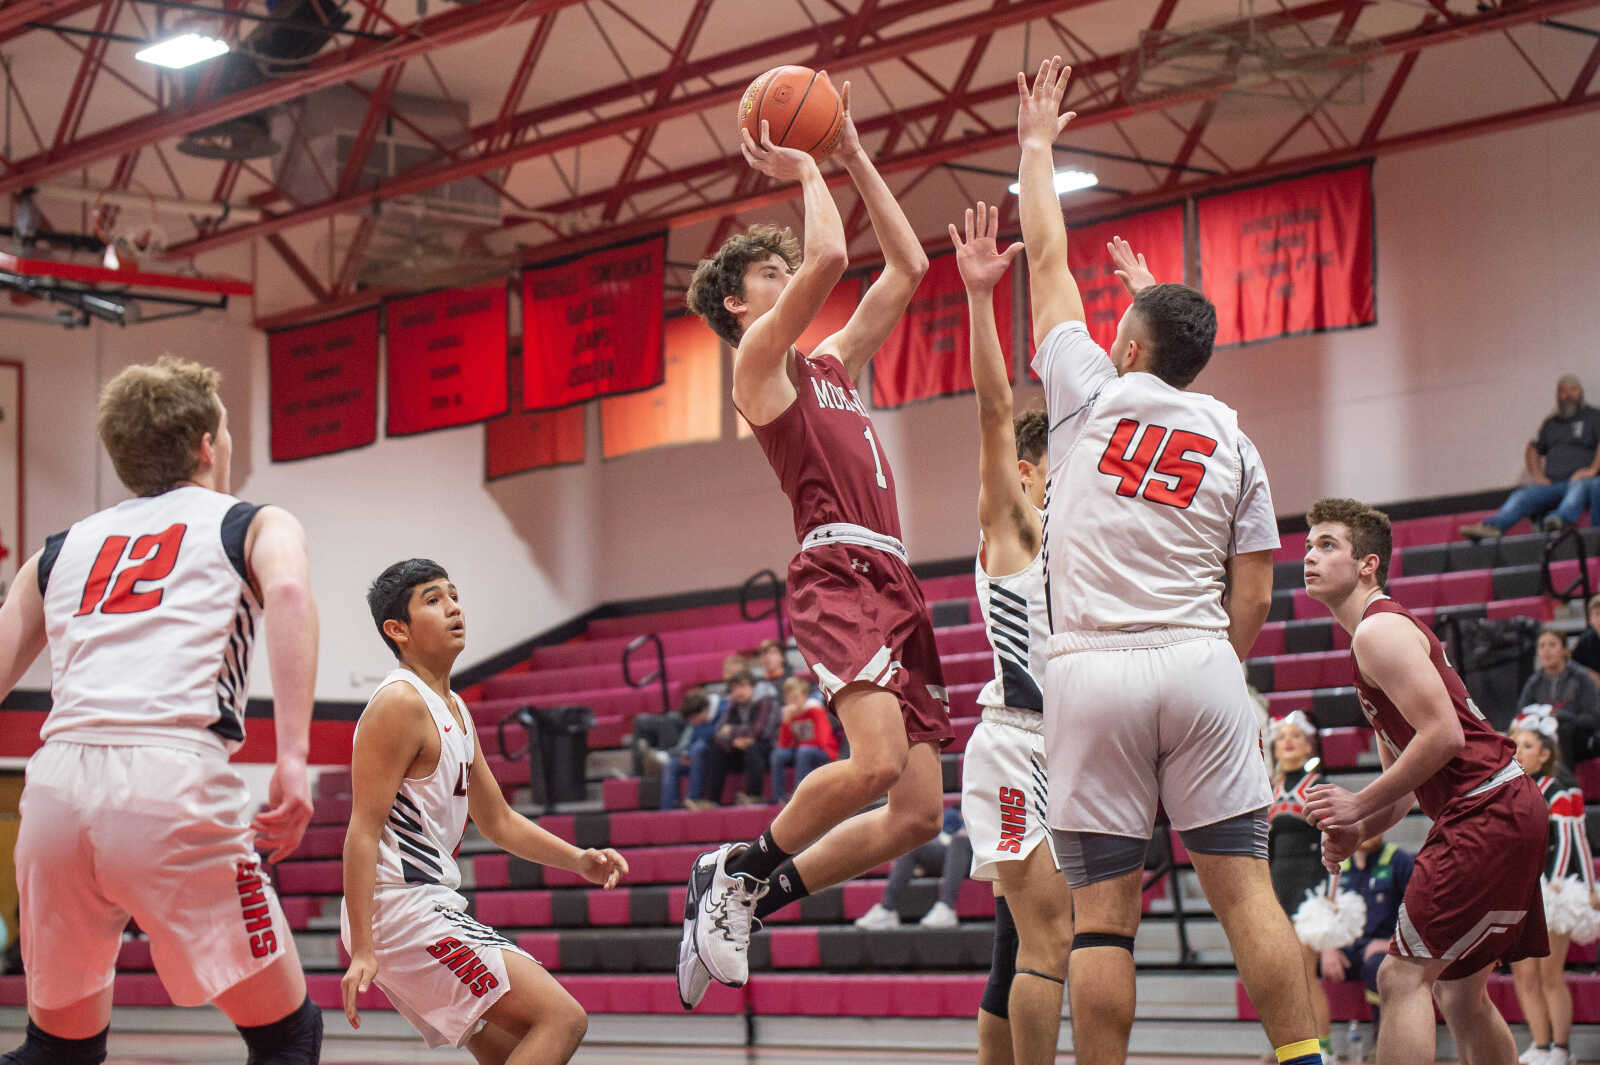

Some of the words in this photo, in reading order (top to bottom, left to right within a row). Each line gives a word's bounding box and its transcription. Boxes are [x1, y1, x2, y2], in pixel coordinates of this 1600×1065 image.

[863, 424, 888, 491] 1
[1097, 417, 1218, 509] 45
[73, 523, 187, 618] 12
[997, 786, 1027, 854] SHHS
[426, 936, 499, 999] SHHS
